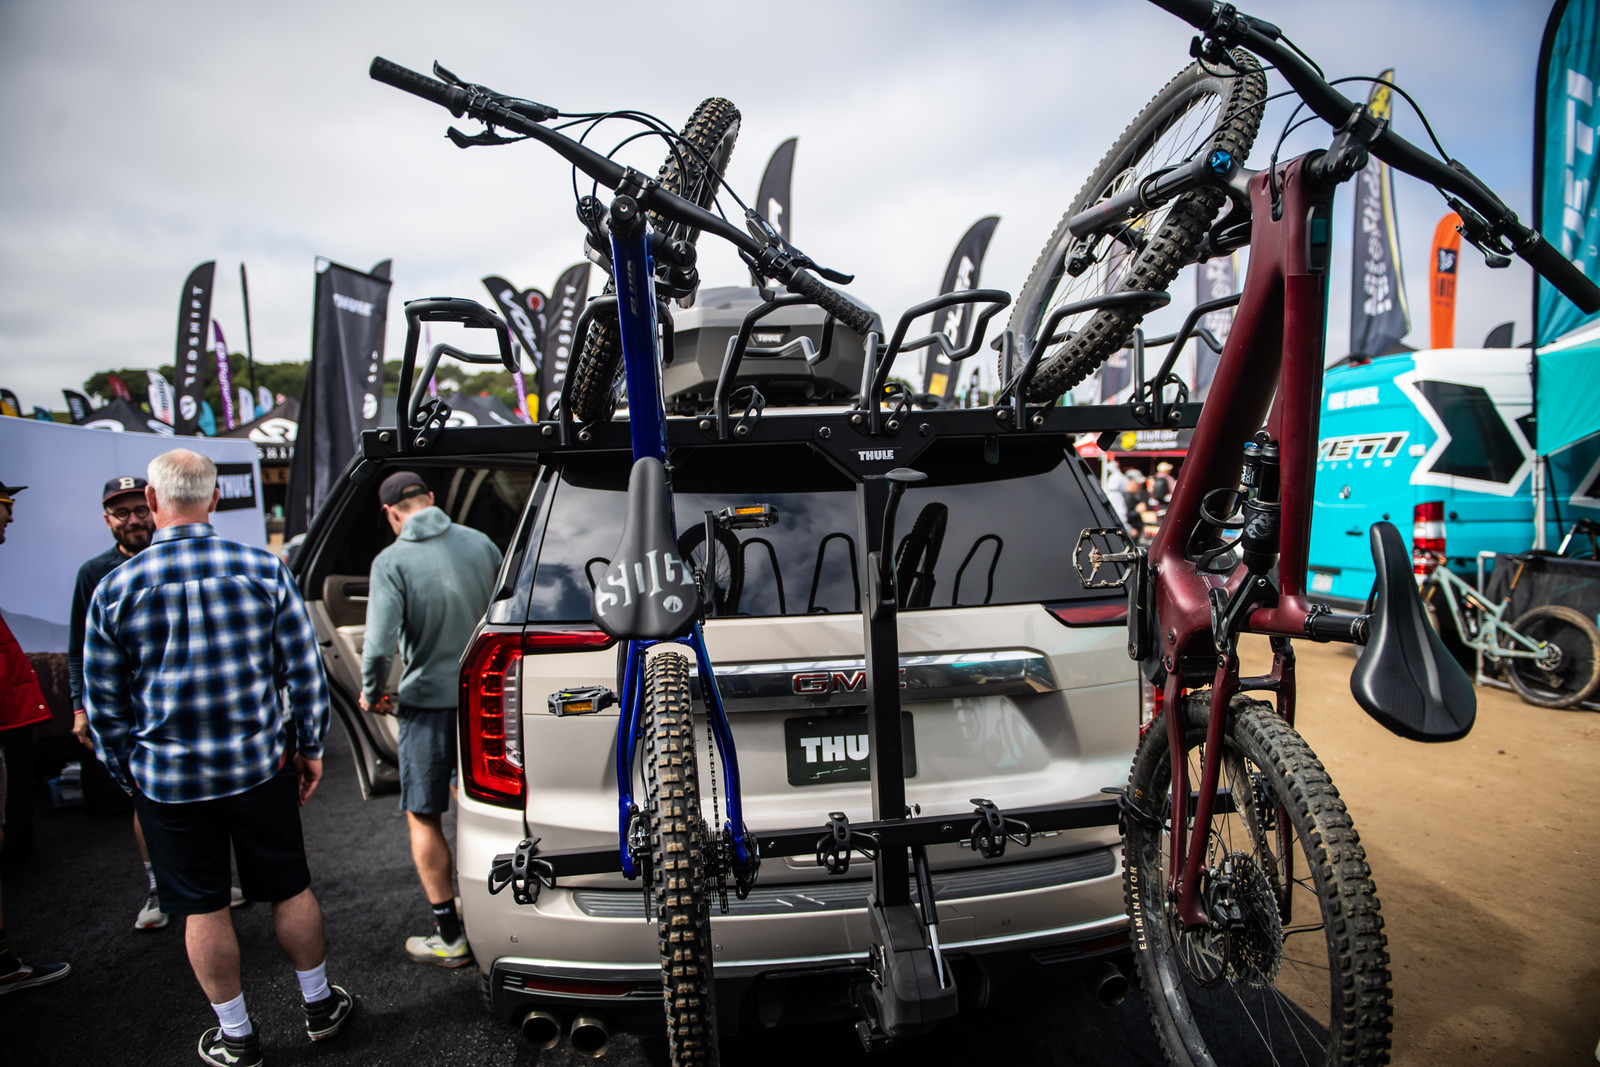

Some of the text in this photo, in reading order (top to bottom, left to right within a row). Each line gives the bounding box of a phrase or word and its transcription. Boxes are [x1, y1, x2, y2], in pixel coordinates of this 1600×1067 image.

[1362, 150, 1393, 317] NiteRide
[757, 333, 781, 343] THULE
[858, 449, 895, 461] THULE
[118, 476, 136, 490] B
[217, 472, 253, 499] THULE
[792, 668, 907, 695] GM
[800, 734, 870, 764] THU
[1130, 865, 1148, 951] ELIMINATOR
